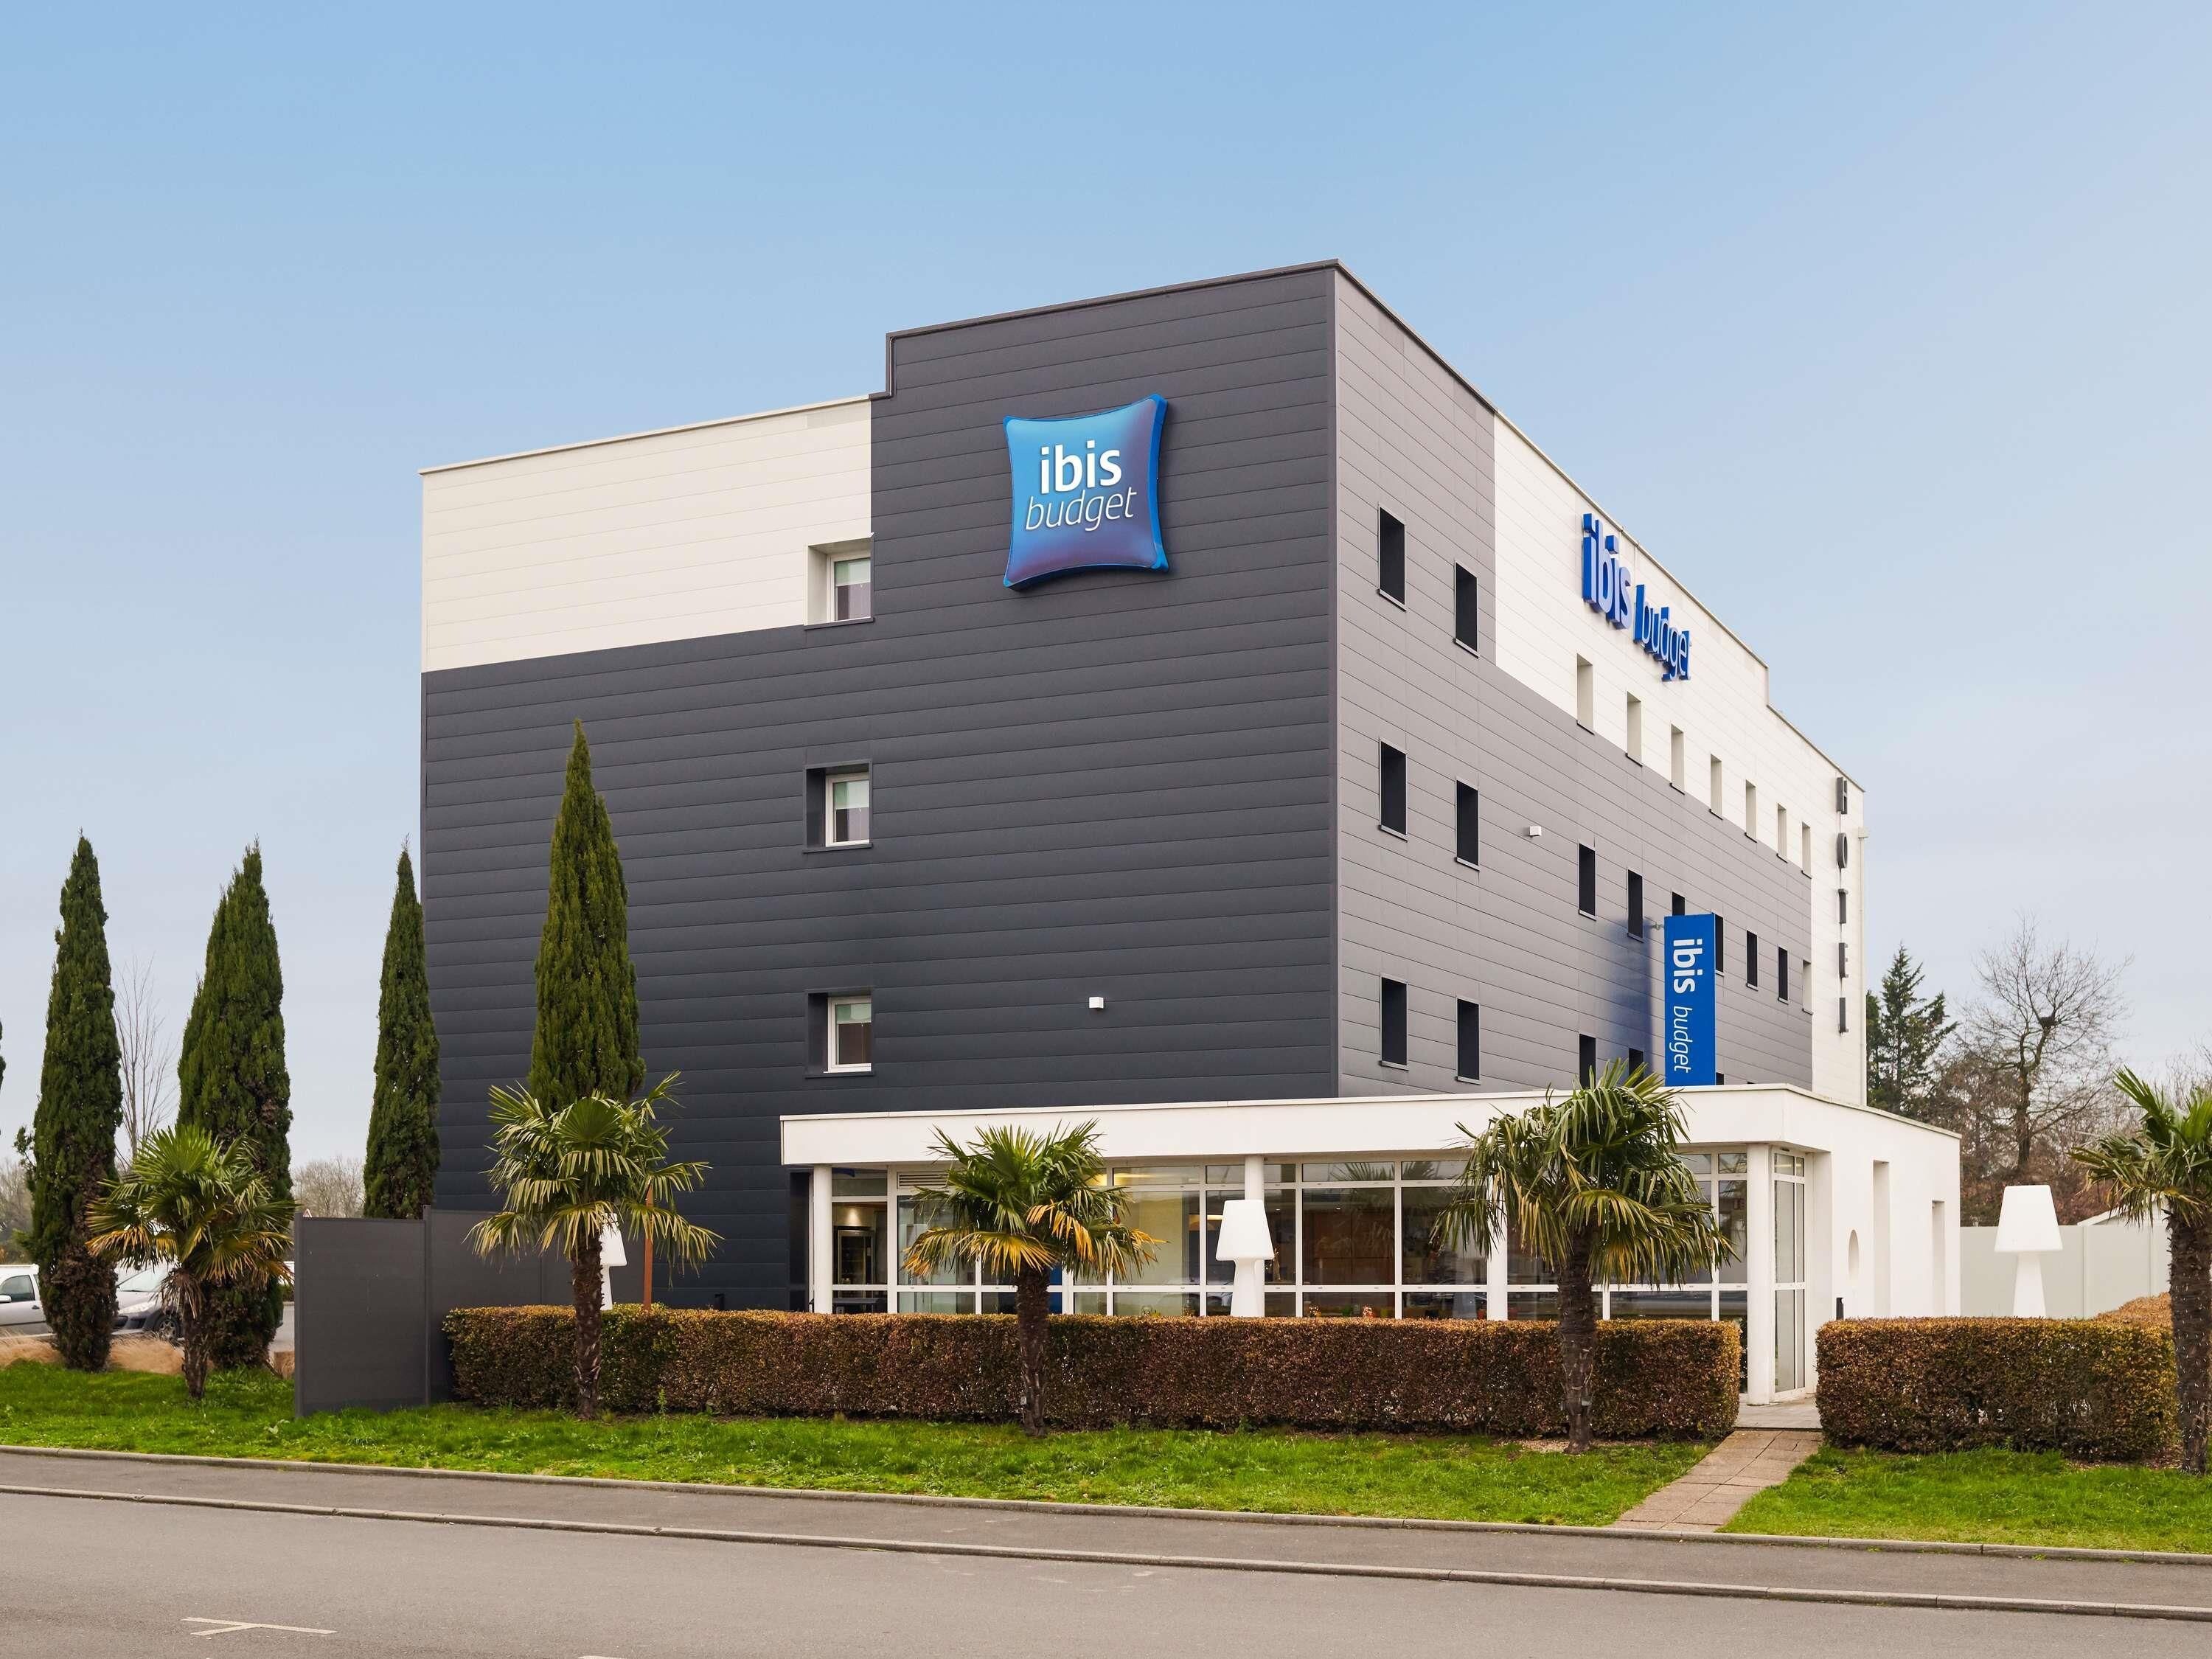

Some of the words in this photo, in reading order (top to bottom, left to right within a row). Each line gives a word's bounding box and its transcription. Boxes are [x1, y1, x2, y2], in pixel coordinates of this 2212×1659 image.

[1040, 440, 1122, 495] ibis
[1026, 487, 1137, 532] budget
[1583, 513, 1632, 629] ibis
[1633, 585, 1691, 681] budget
[1673, 939, 1703, 993] ibis
[1669, 1006, 1693, 1074] budget
